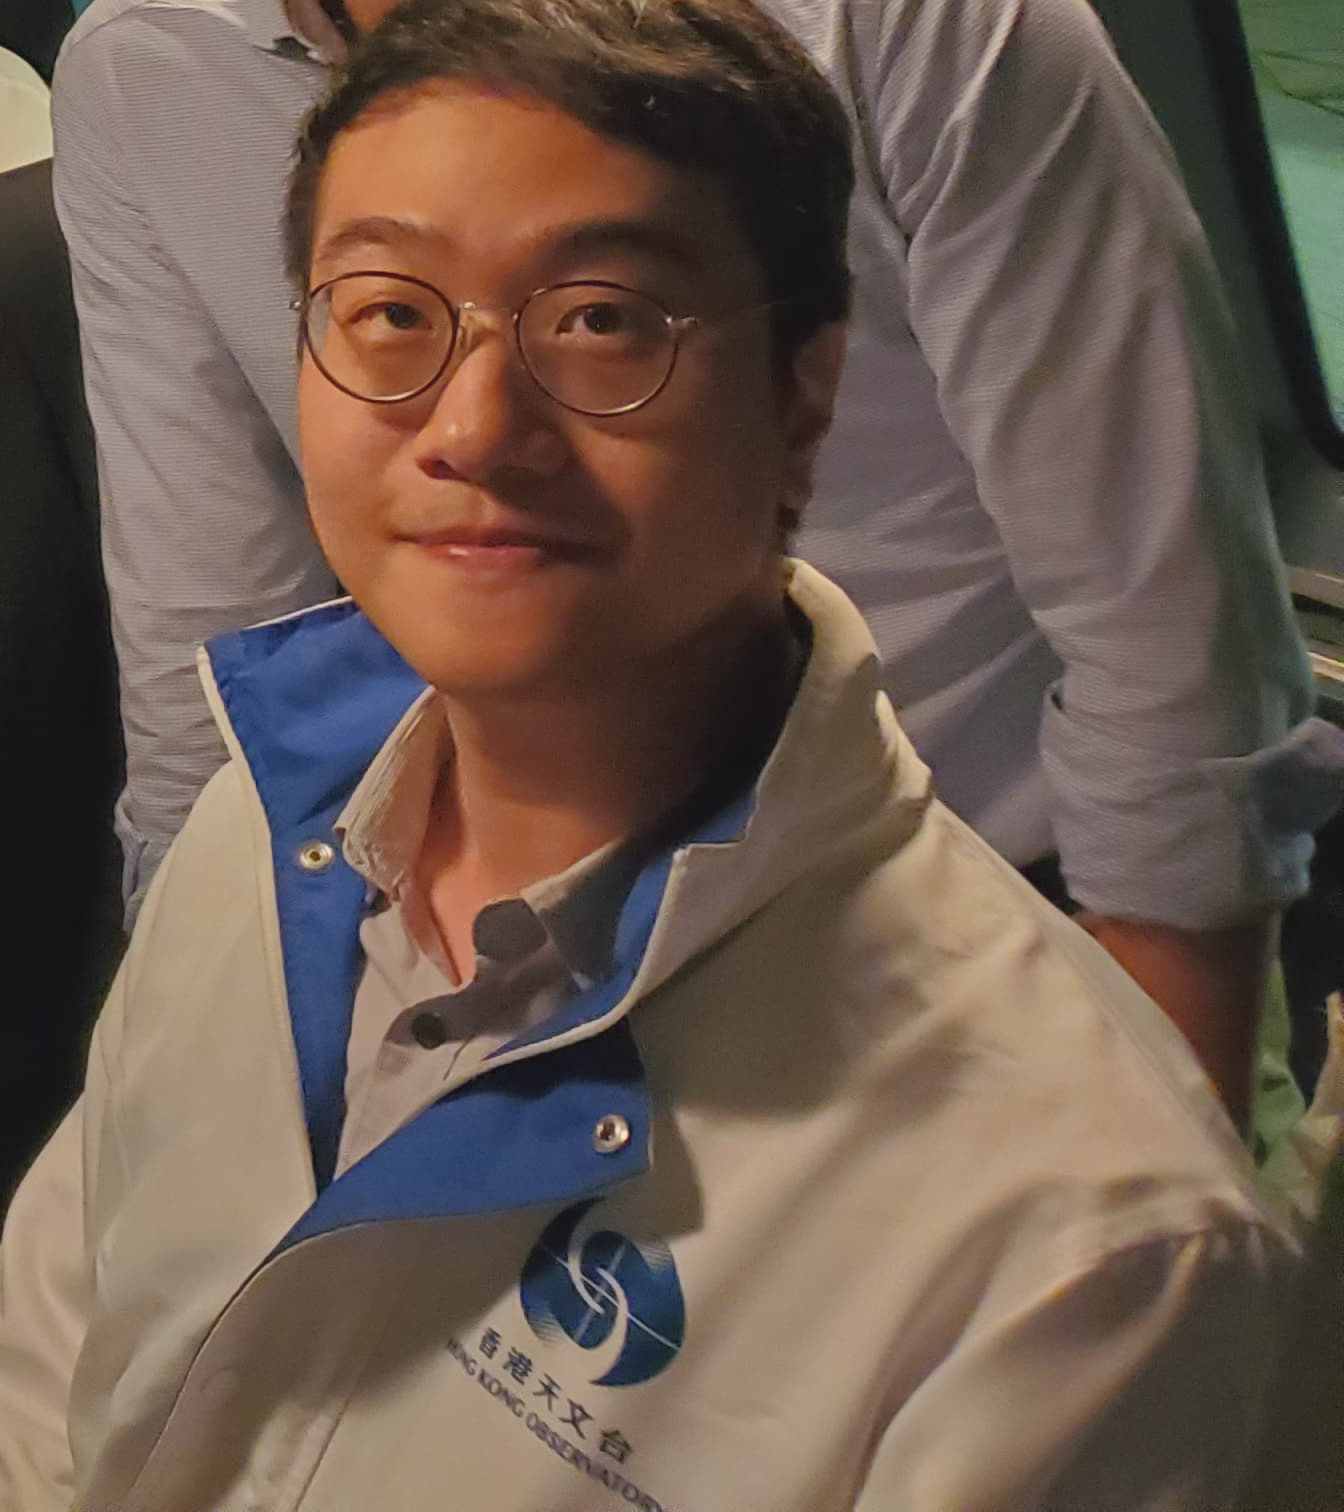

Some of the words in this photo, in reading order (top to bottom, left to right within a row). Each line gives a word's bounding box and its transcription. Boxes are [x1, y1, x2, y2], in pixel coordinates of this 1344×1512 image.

[445, 1336, 478, 1377] HONG
[478, 1368, 526, 1418] KONG
[479, 1327, 633, 1465] 香港天文台
